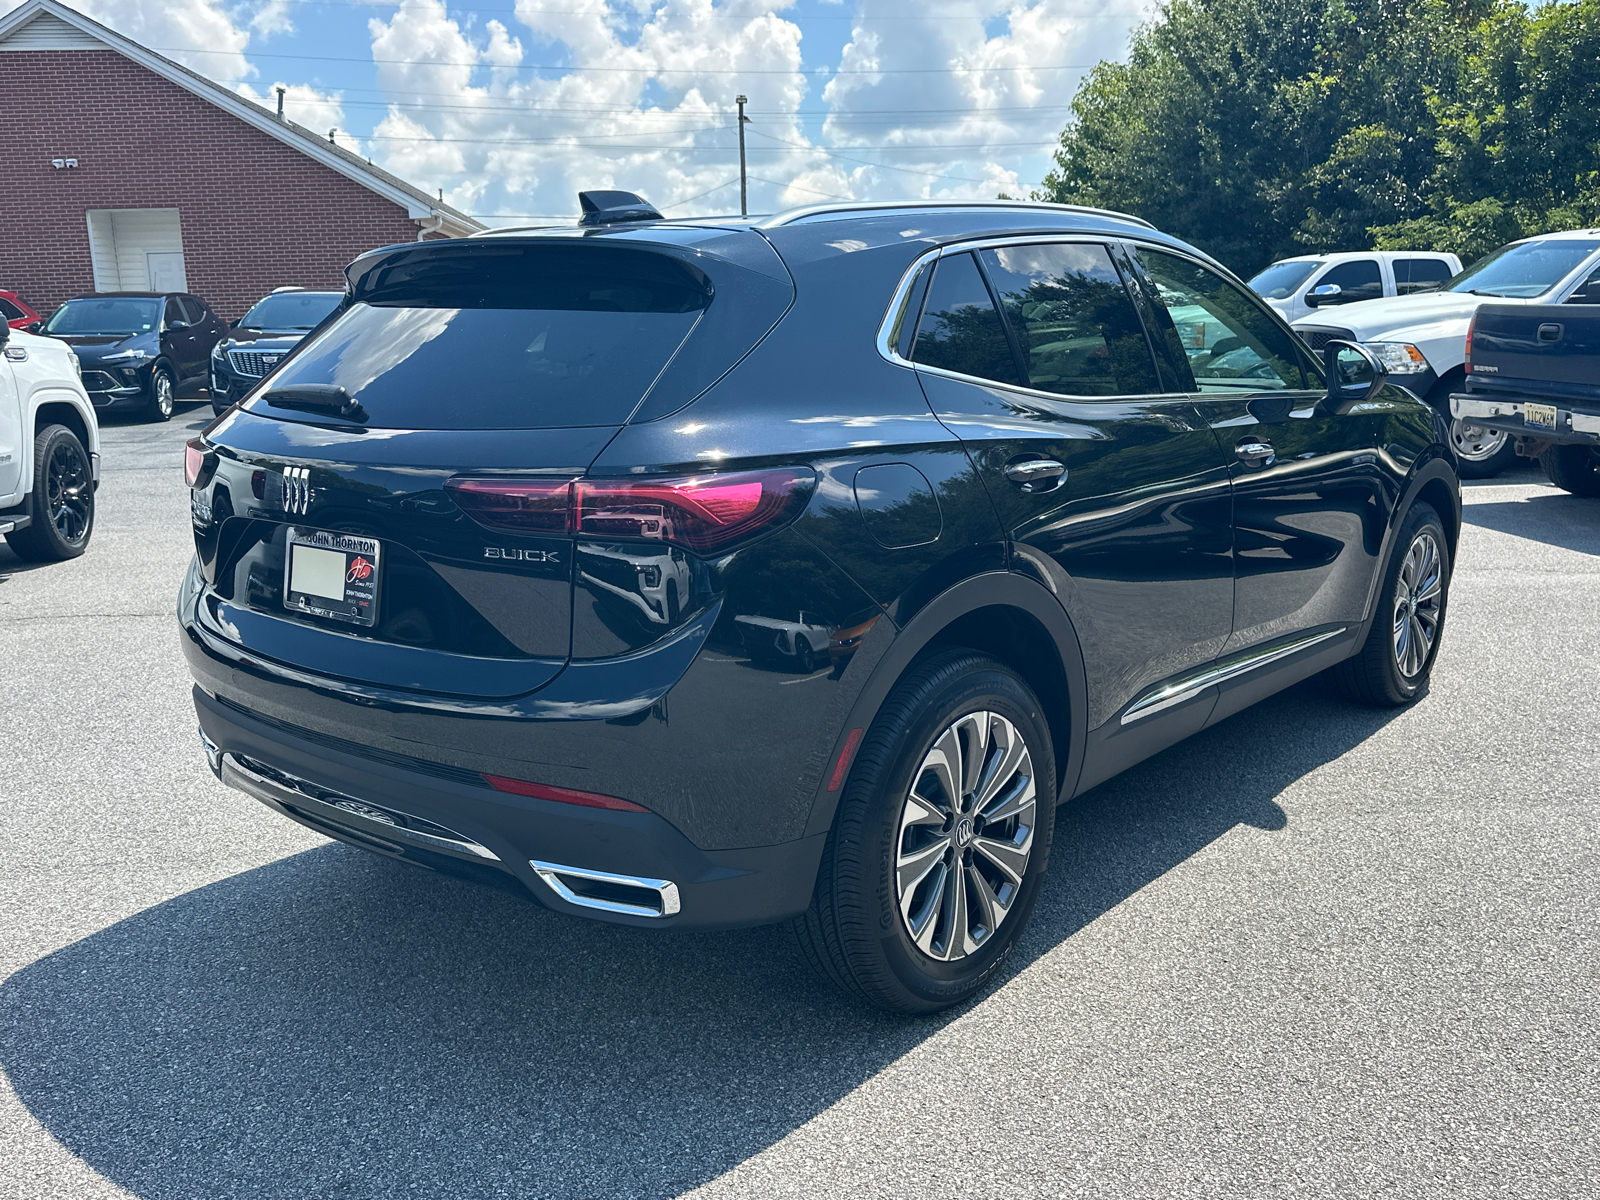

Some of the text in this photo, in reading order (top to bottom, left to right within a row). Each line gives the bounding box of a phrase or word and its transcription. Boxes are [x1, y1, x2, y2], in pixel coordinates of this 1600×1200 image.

[332, 537, 375, 553] THORNTON
[483, 546, 561, 563] BUICK
[875, 819, 896, 931] Continental
